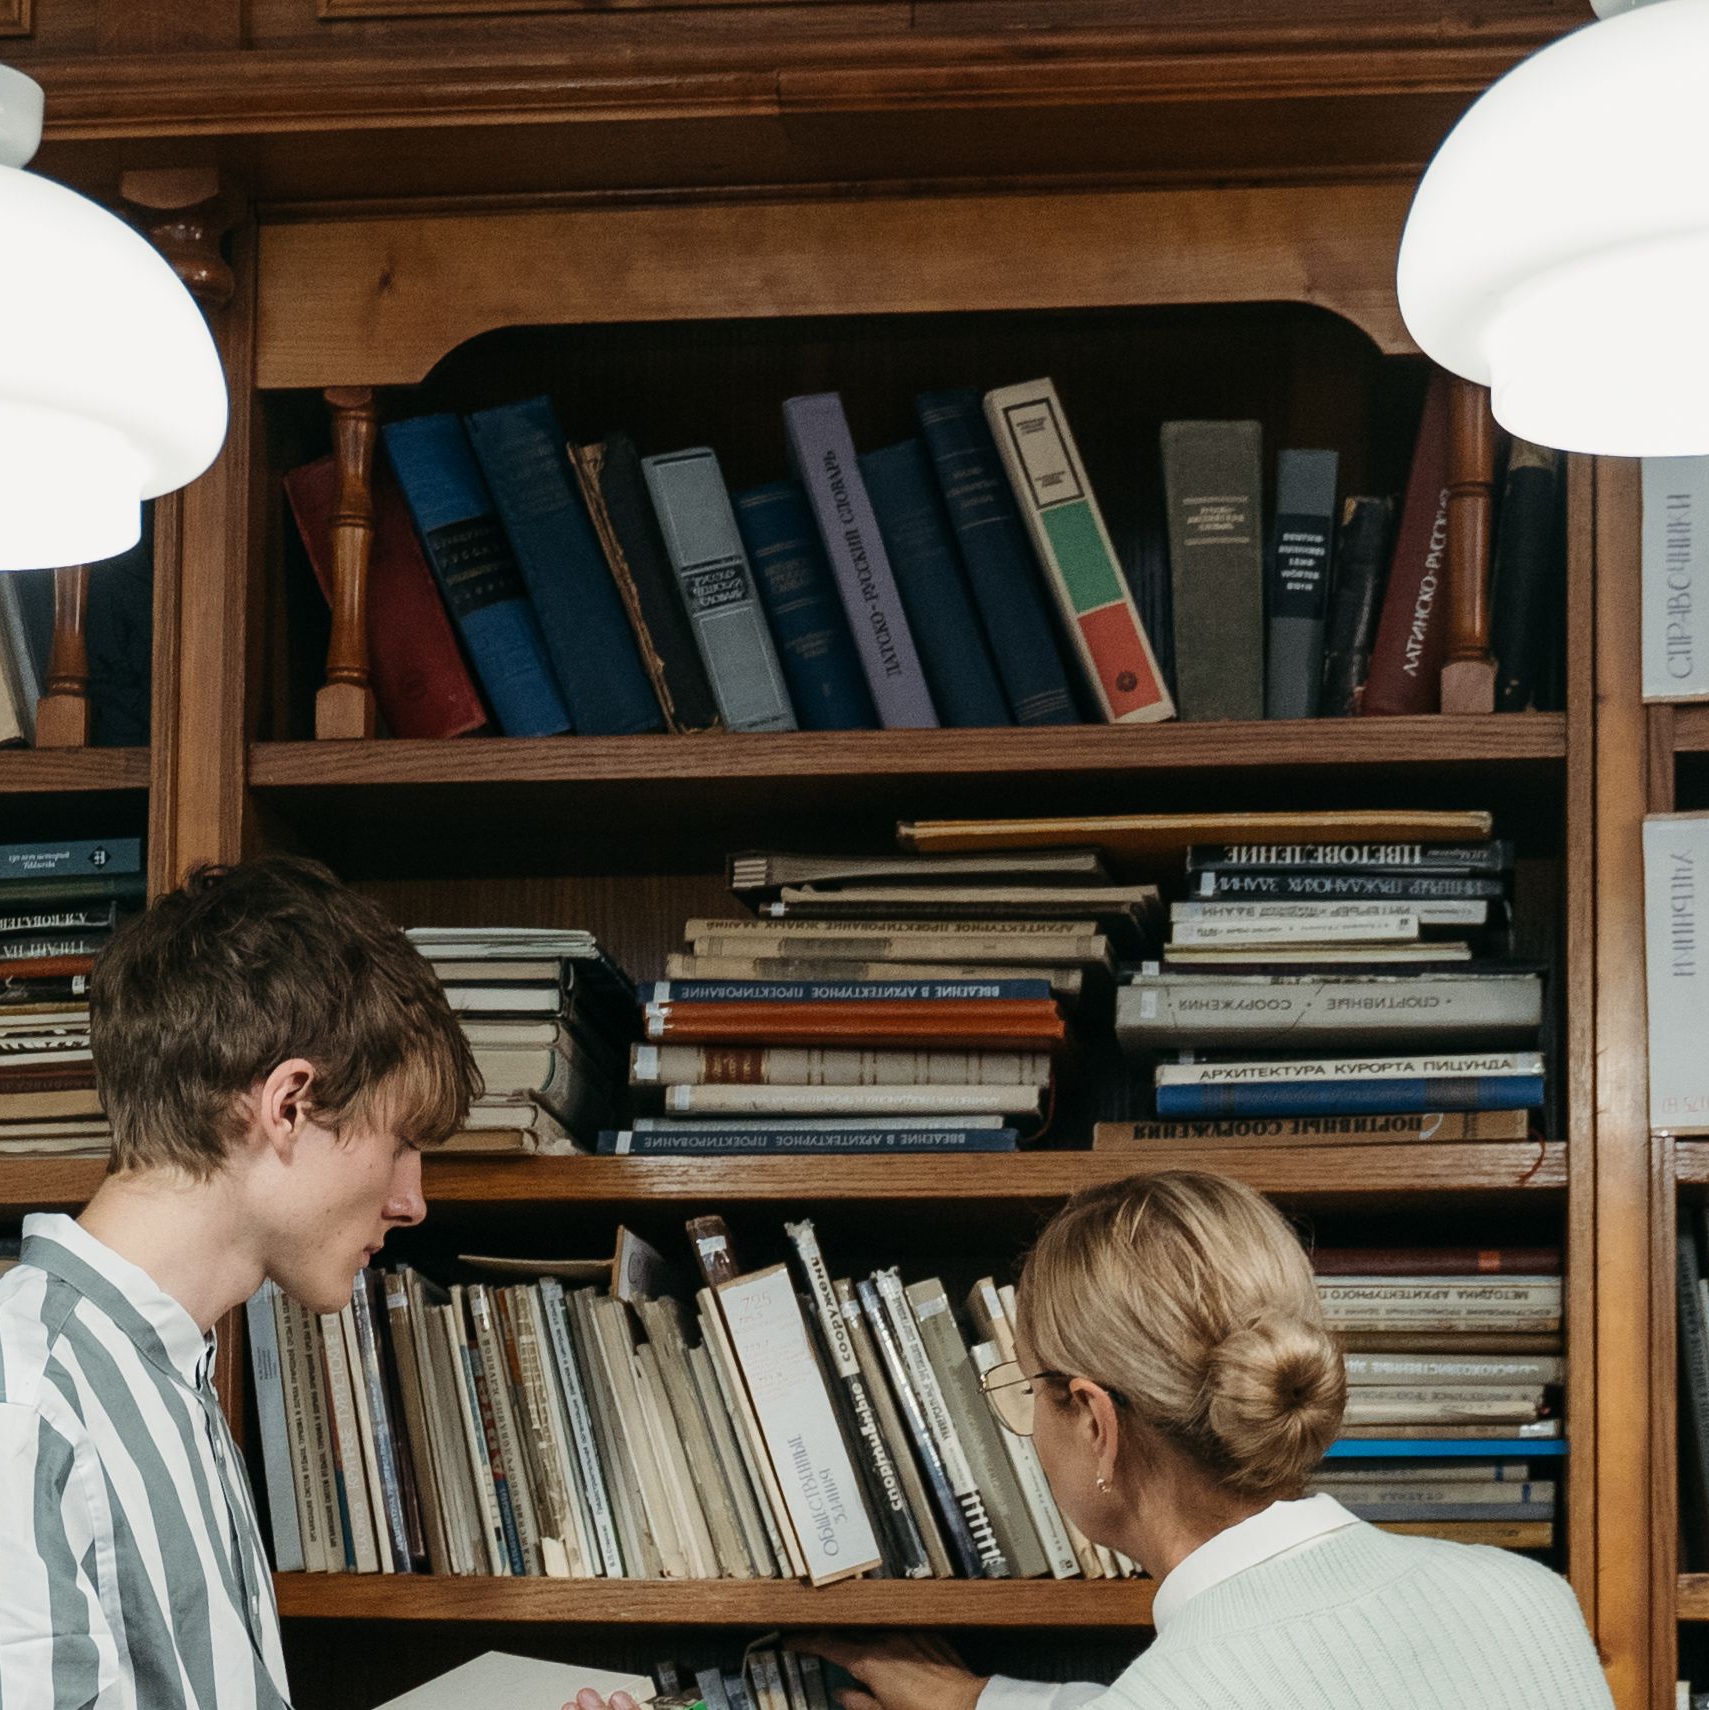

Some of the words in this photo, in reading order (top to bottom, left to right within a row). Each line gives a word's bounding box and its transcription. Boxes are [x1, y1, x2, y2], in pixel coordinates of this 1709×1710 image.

[821, 450, 855, 525] СЛОВАРЬ
[1665, 492, 1693, 679] СПРАВОЧНИКИ
[844, 528, 902, 677] ДАТСКО-РУССКИЙ
[1224, 845, 1422, 866] ЦВЕТОВЕДЕНИЕ
[680, 986, 804, 1001] ПРОЕКТИРОВАНИЕ
[811, 986, 917, 1000] АРХИТЕКТУРНОЕ
[934, 986, 1001, 1000] ВВЕДЕНИЕ
[1327, 997, 1440, 1010] СПОРТИВНЫЕ
[1178, 998, 1293, 1011] СООРУЖЕНИЯ
[1199, 1064, 1326, 1081] АРХИТЕКТУРА
[1334, 1062, 1416, 1075] КУРОРТА
[1423, 1058, 1513, 1073] ПИЦУНДА
[900, 1131, 967, 1145] ВВЕДЕНИЕ
[849, 1382, 904, 1511] спортивные
[785, 1433, 841, 1557] ОБЩЕСТВЕННЫЕ
